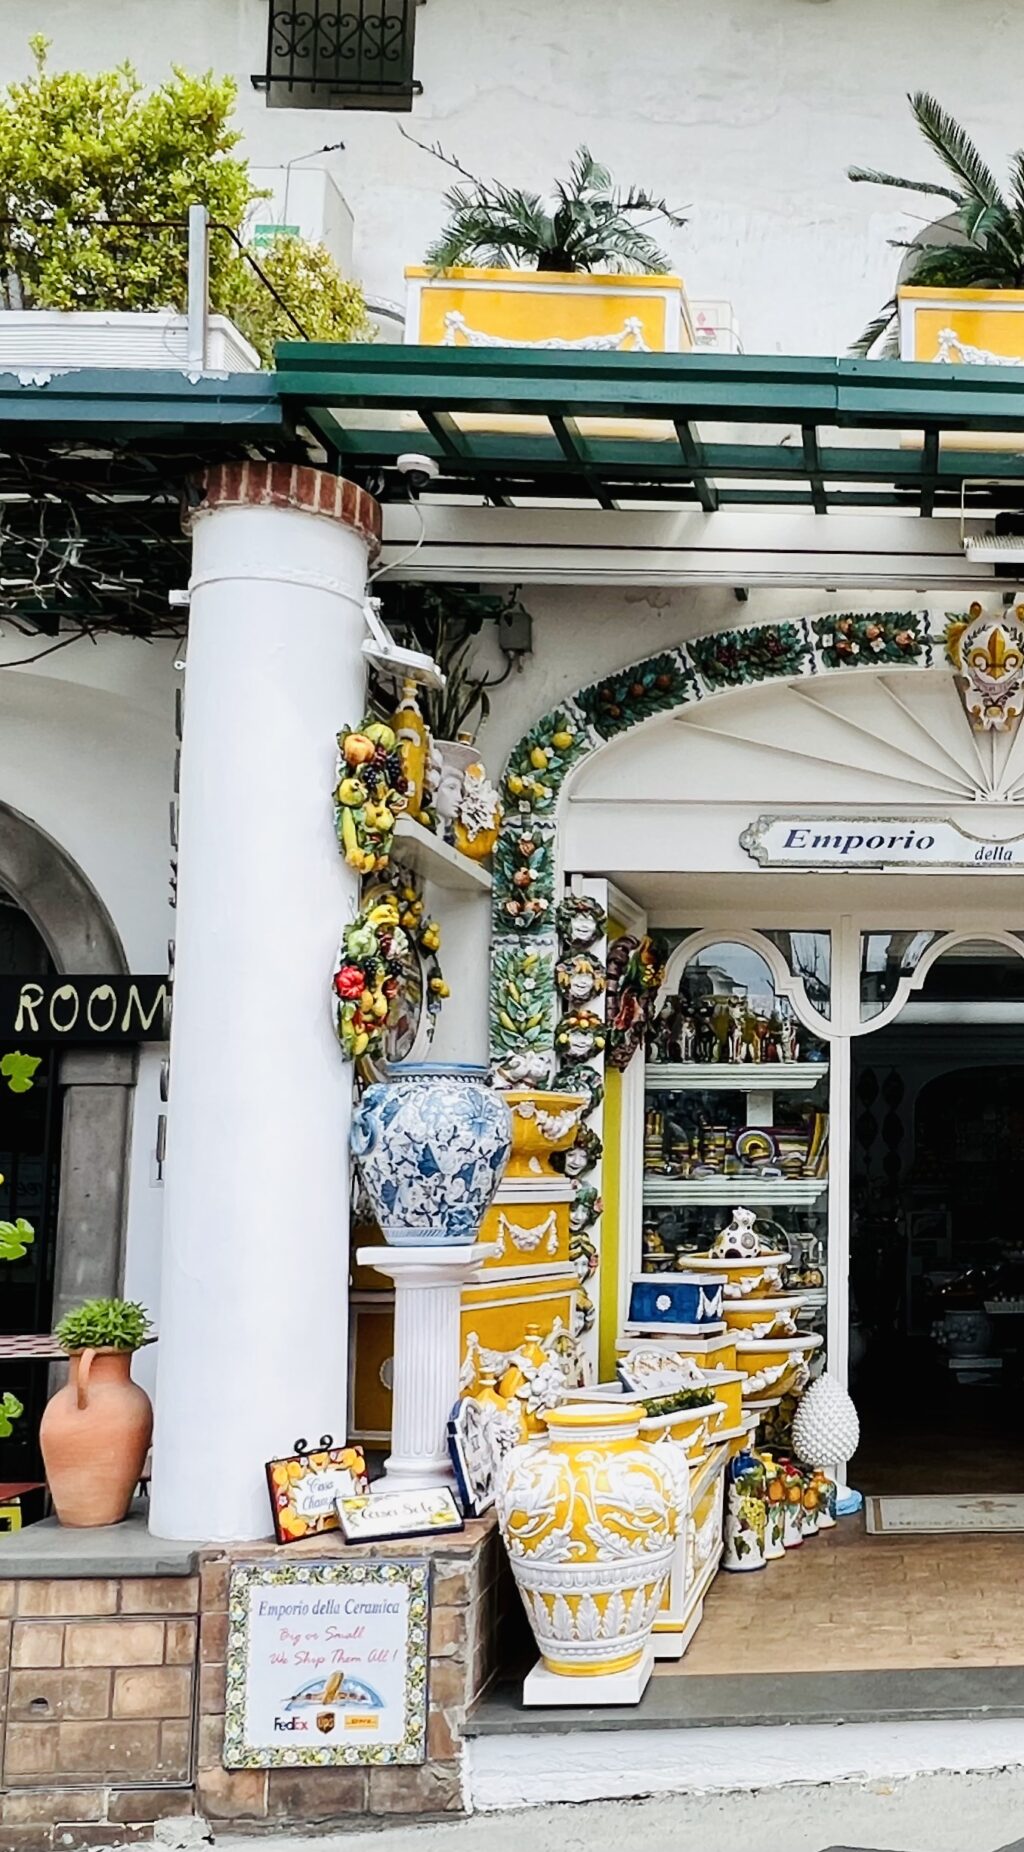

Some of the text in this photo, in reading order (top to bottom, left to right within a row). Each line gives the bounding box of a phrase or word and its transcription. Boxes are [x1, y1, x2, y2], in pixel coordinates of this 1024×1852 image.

[783, 829, 935, 854] Emporio
[974, 845, 1012, 863] della
[14, 983, 167, 1033] ROOM
[258, 1598, 400, 1620] Emporio della Ceramica
[325, 1625, 366, 1641] Small
[330, 1649, 362, 1664] Them
[274, 1716, 309, 1731] FedEx
